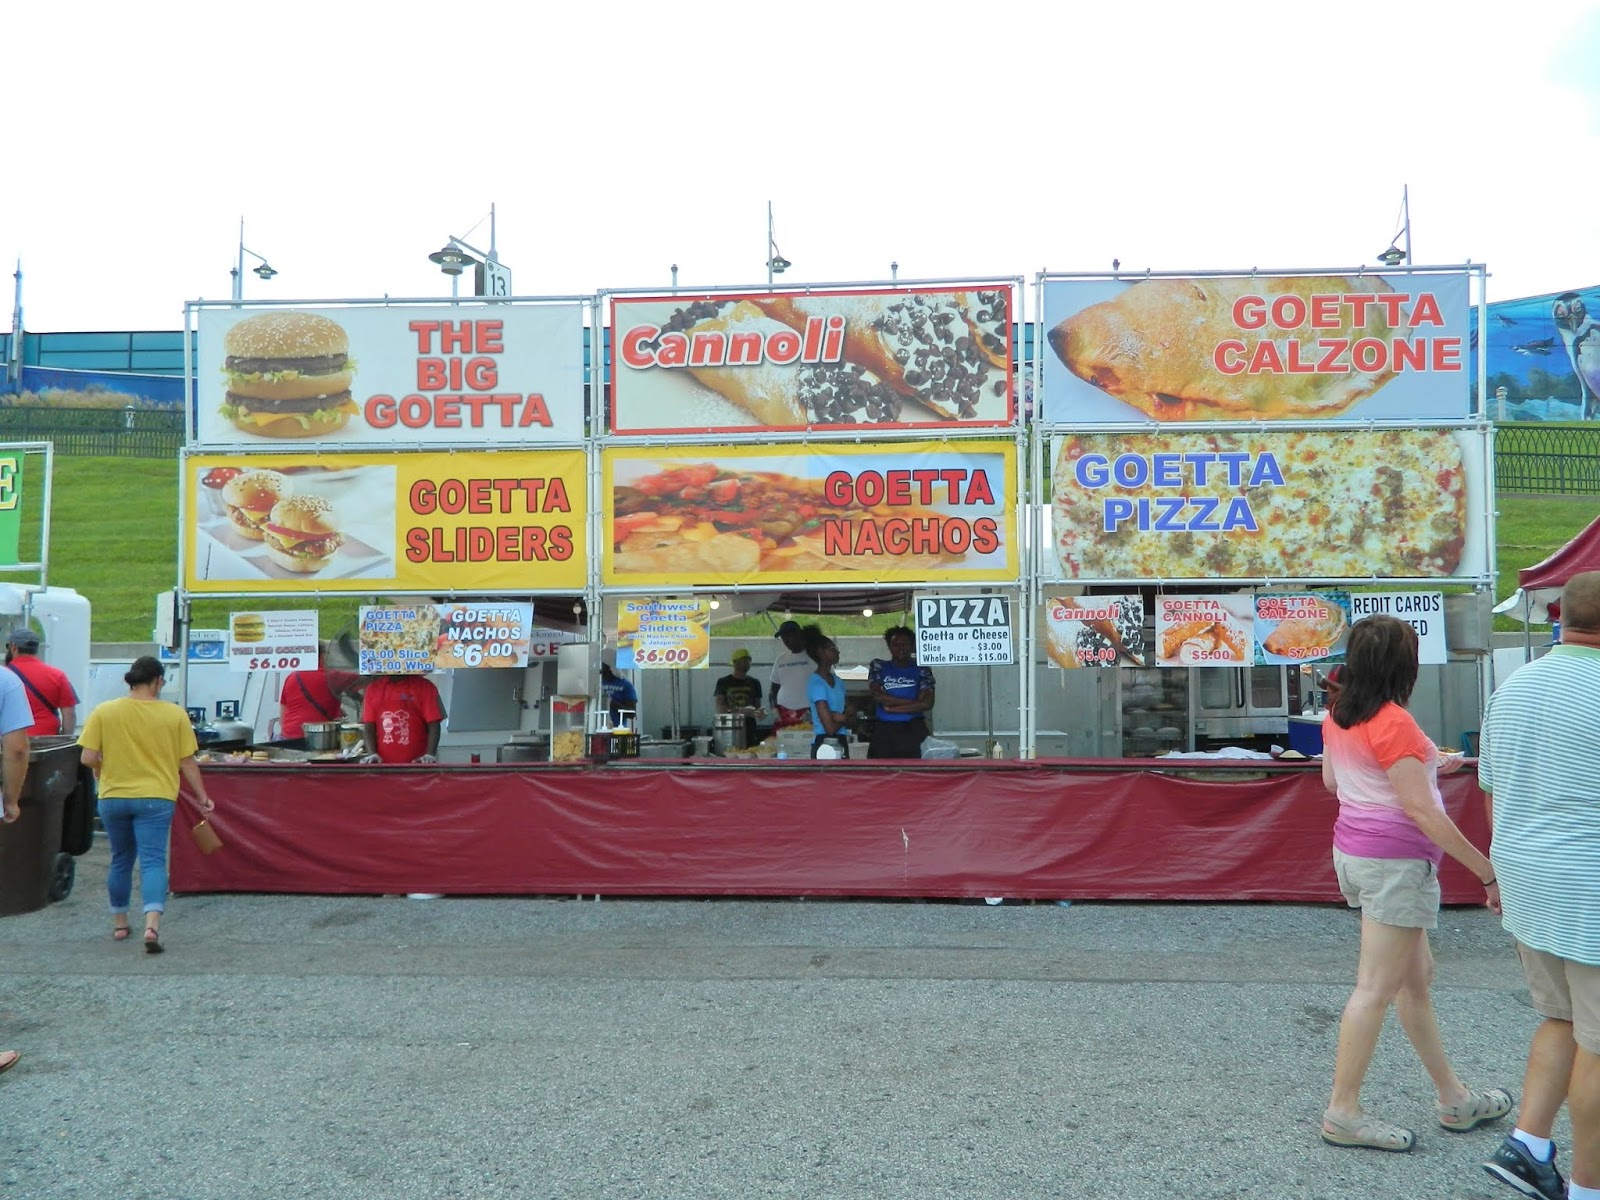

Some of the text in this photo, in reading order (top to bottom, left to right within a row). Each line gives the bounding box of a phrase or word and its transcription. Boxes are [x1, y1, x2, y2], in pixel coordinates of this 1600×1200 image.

[491, 273, 506, 296] 13
[1232, 293, 1444, 330] GOETTA
[409, 320, 504, 354] THE
[621, 315, 846, 369] Cannoli
[1213, 337, 1462, 374] CALZONE
[416, 357, 498, 391] BIG
[364, 394, 553, 429] GOETTA
[1075, 452, 1285, 489] GOETTA
[0, 457, 17, 510] E
[825, 469, 995, 507] GOETTA
[410, 477, 571, 515] GOETTA
[1103, 497, 1259, 532] PIZZA
[825, 517, 999, 556] NACHOS
[406, 525, 574, 563] SLIDERS
[627, 603, 700, 612] Southwest
[1163, 600, 1220, 610] GOETTA
[1257, 597, 1317, 608] GOETTA
[1353, 595, 1440, 614] REDIT CARDS
[366, 610, 416, 620] GOETTA
[452, 609, 522, 623] GOETTA
[640, 614, 687, 622] Goetta
[921, 598, 1005, 626] PIZZA
[1052, 604, 1120, 621] Cannoli
[1163, 612, 1227, 622] CANNOLI
[1257, 608, 1328, 620] CALZONE
[366, 622, 402, 631] PIZZA
[448, 627, 522, 640] NACHOS
[639, 624, 687, 632] Sliders
[1402, 620, 1428, 636] ED
[921, 628, 1008, 641] Goetta or Cheese
[532, 642, 560, 656] CE
[923, 644, 941, 652] Slice
[978, 642, 1002, 651] $3.00
[1289, 647, 1329, 658] $7.00
[361, 650, 429, 660] $3.00 Slice
[453, 643, 513, 667] $6.00
[635, 649, 689, 663] $6.00
[923, 654, 946, 662] Whole
[949, 653, 969, 662] Pizza
[978, 652, 1008, 661] $15.00
[1076, 648, 1116, 662] $5.00
[1192, 650, 1230, 661] $5.00
[249, 657, 300, 670] $6.00
[361, 661, 435, 672] $15.00 Whol
